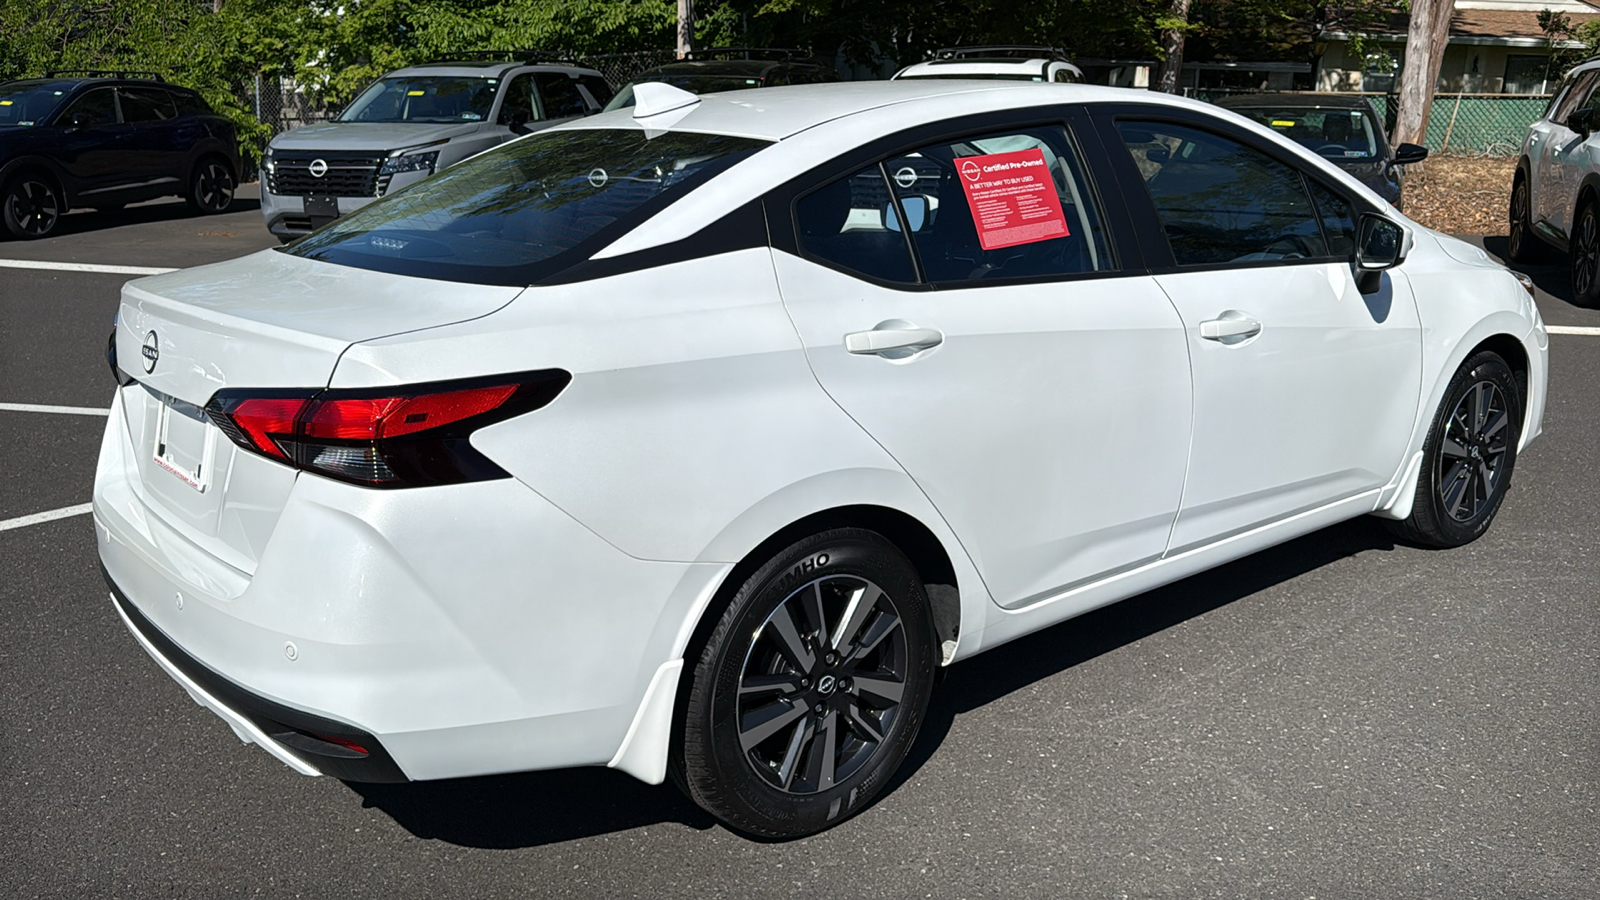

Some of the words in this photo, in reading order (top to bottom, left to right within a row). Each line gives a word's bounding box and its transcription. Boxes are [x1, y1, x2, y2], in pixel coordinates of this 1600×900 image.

[983, 163, 1010, 172] Certified
[1010, 159, 1043, 168] Pre-Owned
[771, 554, 830, 596] UMHO
